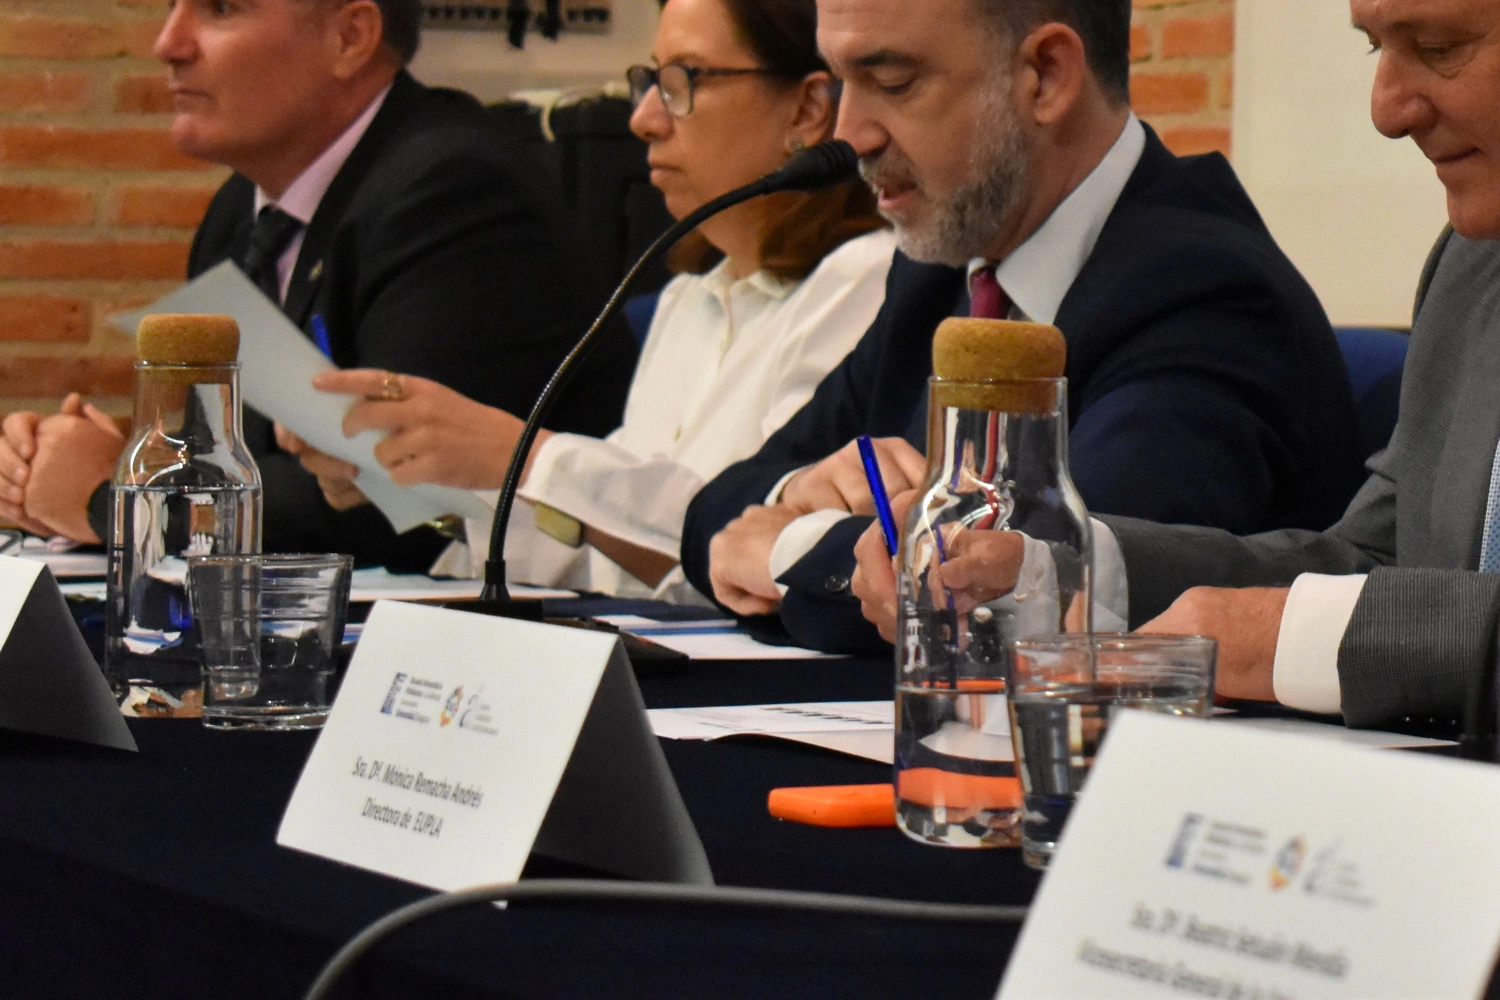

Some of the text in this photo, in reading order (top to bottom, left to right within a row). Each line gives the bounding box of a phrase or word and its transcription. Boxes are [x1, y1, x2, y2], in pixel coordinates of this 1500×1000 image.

[352, 756, 368, 777] Sra.
[382, 763, 415, 790] Mónica
[413, 771, 452, 800] Remacha
[449, 782, 484, 809] Andrés
[362, 797, 444, 837] Directora de EUPLA
